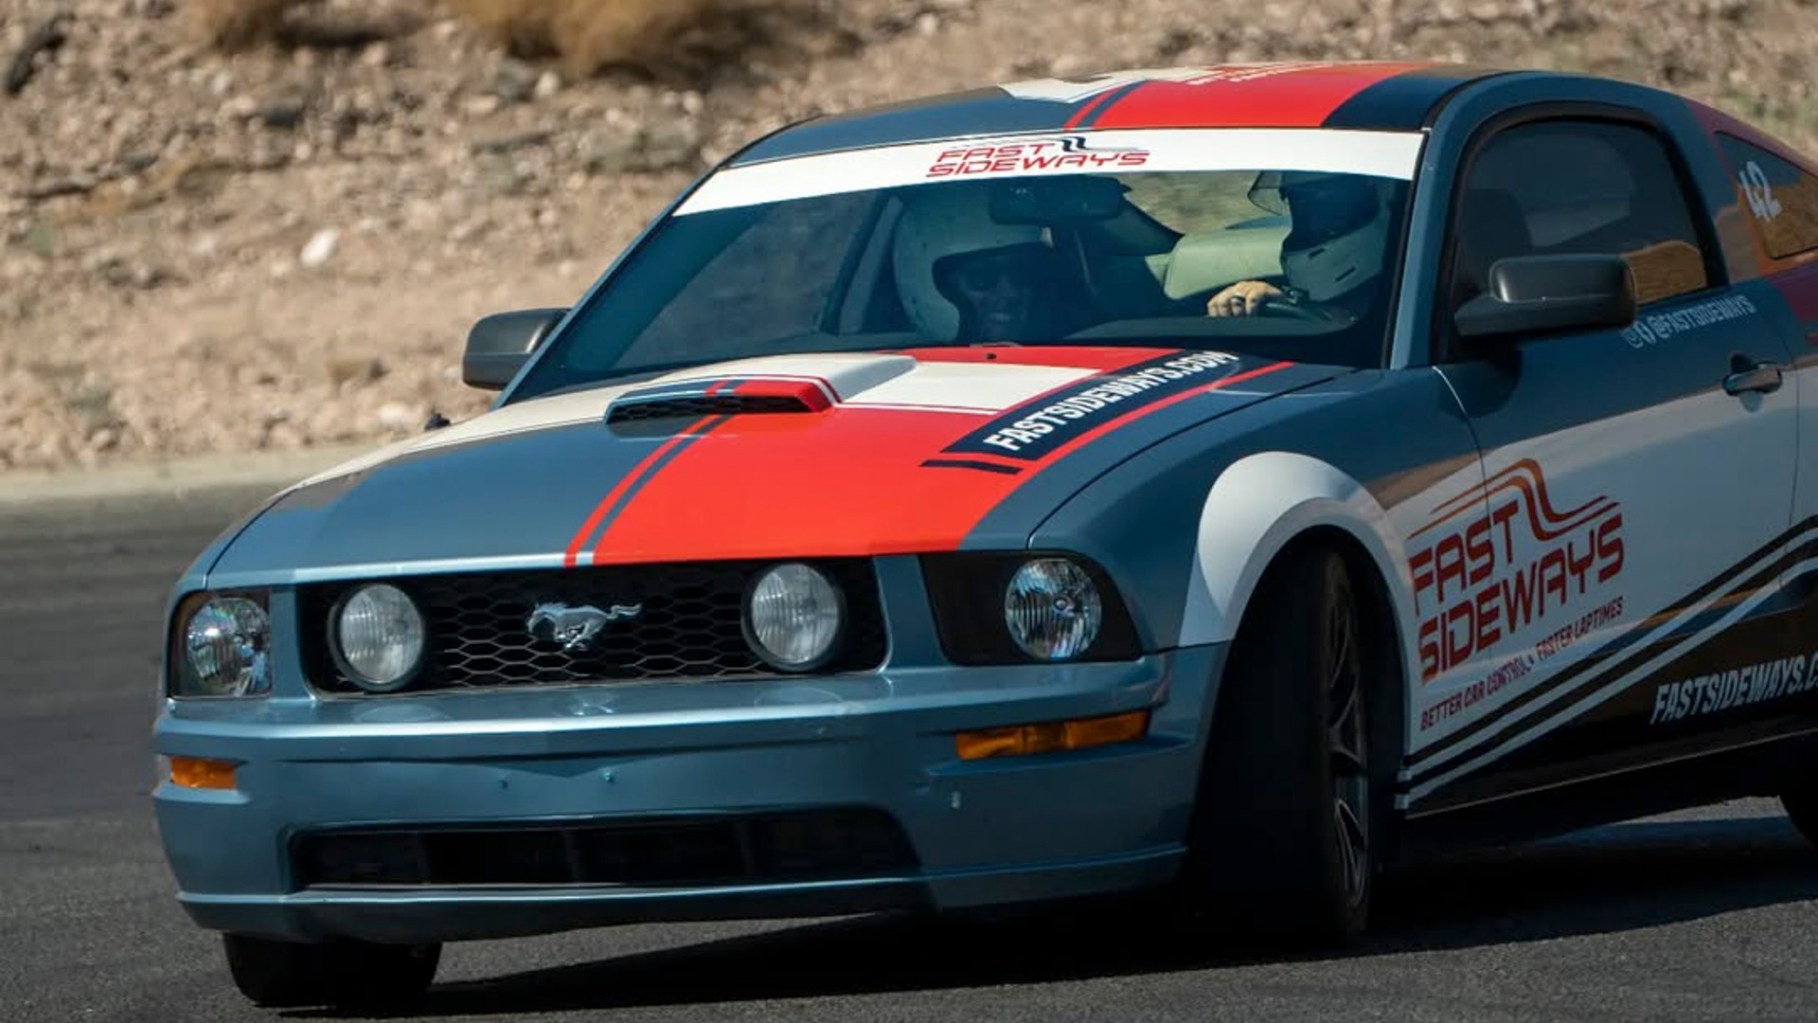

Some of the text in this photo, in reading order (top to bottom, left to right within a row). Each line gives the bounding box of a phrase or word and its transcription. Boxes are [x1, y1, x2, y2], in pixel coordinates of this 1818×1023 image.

[926, 152, 1149, 177] SIDEWAYS
[937, 145, 1056, 162] FAST
[983, 351, 1239, 450] FASTSIDEWAYS.COM
[1408, 501, 1519, 616] FAST
[1419, 513, 1624, 685] SIDEWAYS
[1420, 596, 1623, 731] BETTER CAR CONTROL FASTER LAPTIMES
